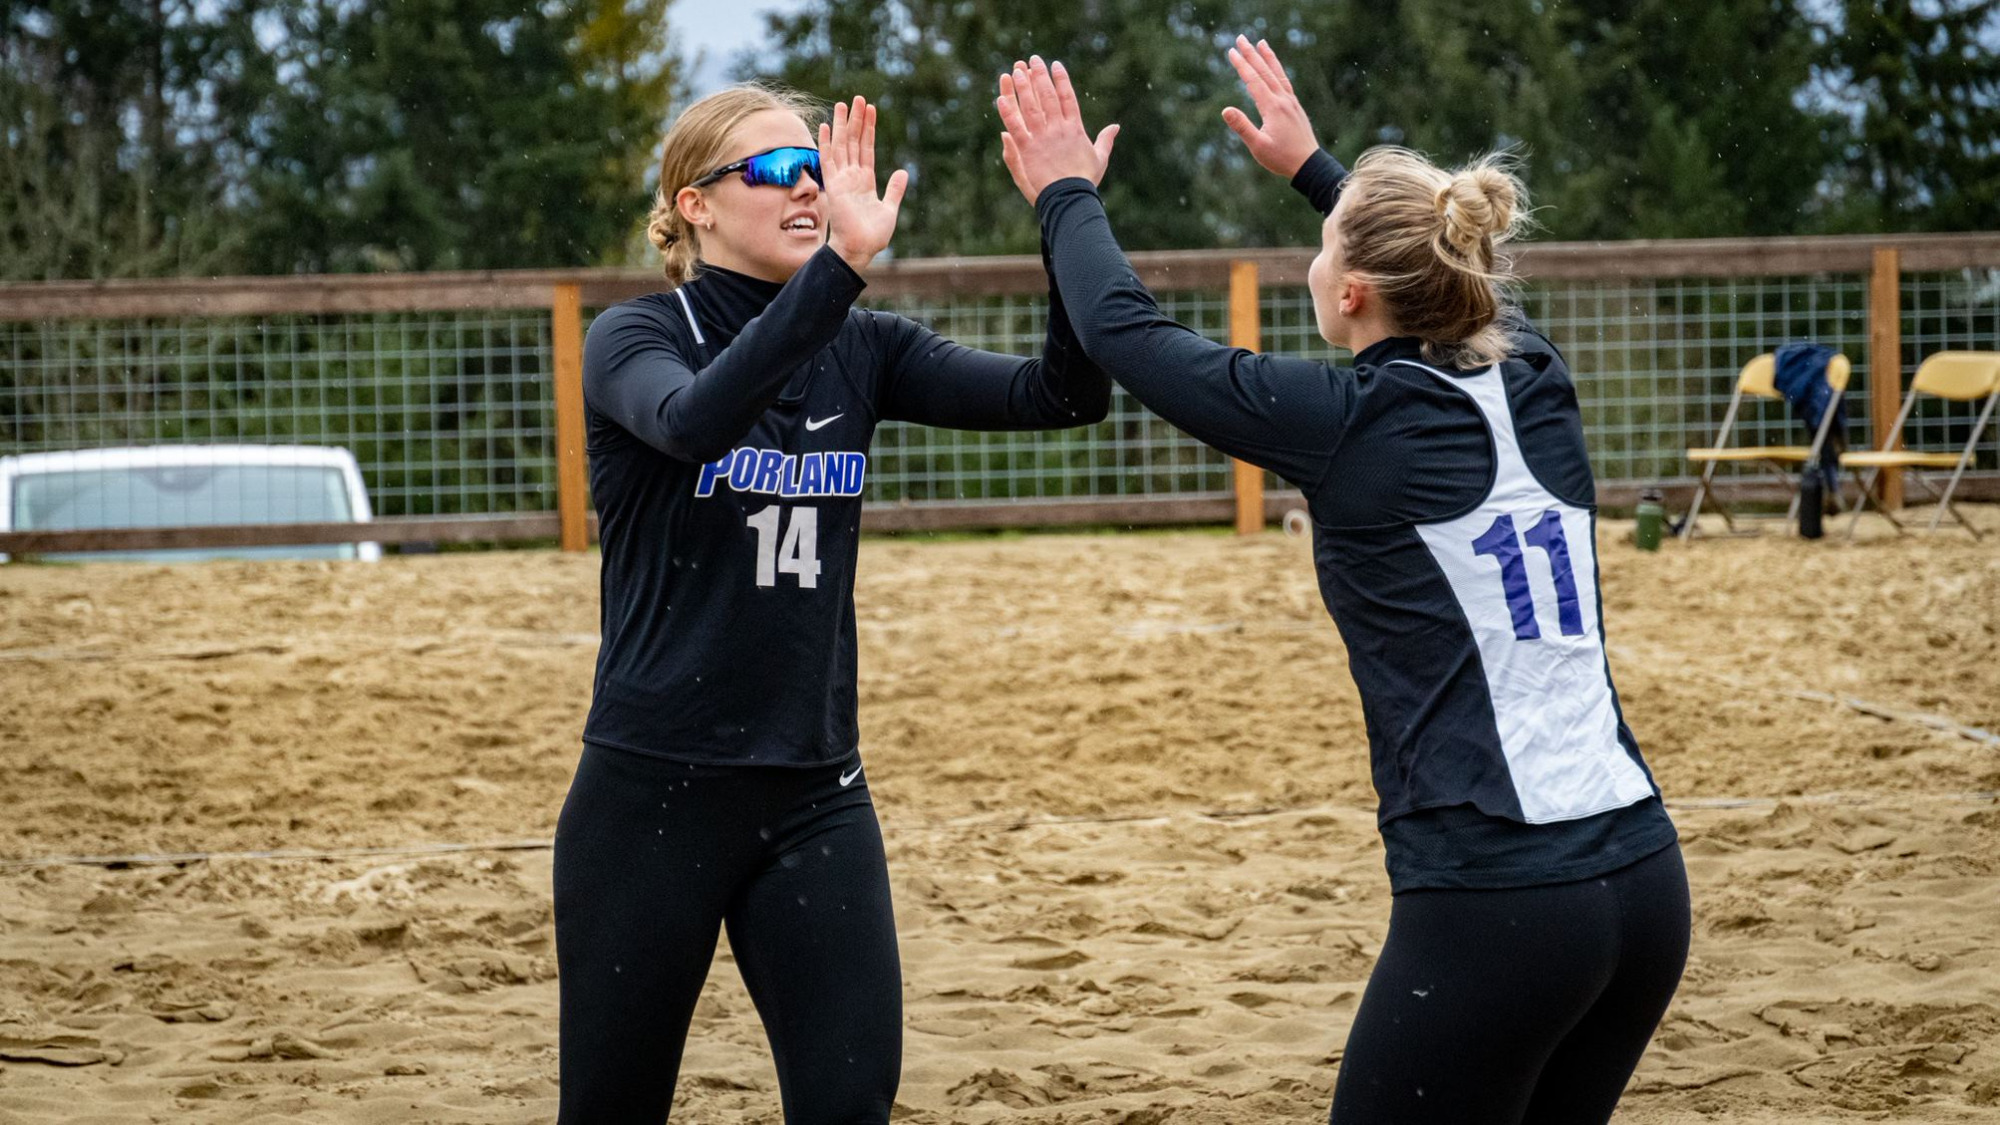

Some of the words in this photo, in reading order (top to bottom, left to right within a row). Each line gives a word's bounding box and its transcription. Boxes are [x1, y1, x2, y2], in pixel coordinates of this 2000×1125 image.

[694, 447, 866, 497] PORLAND
[746, 504, 821, 589] 14
[1471, 510, 1584, 641] 11
